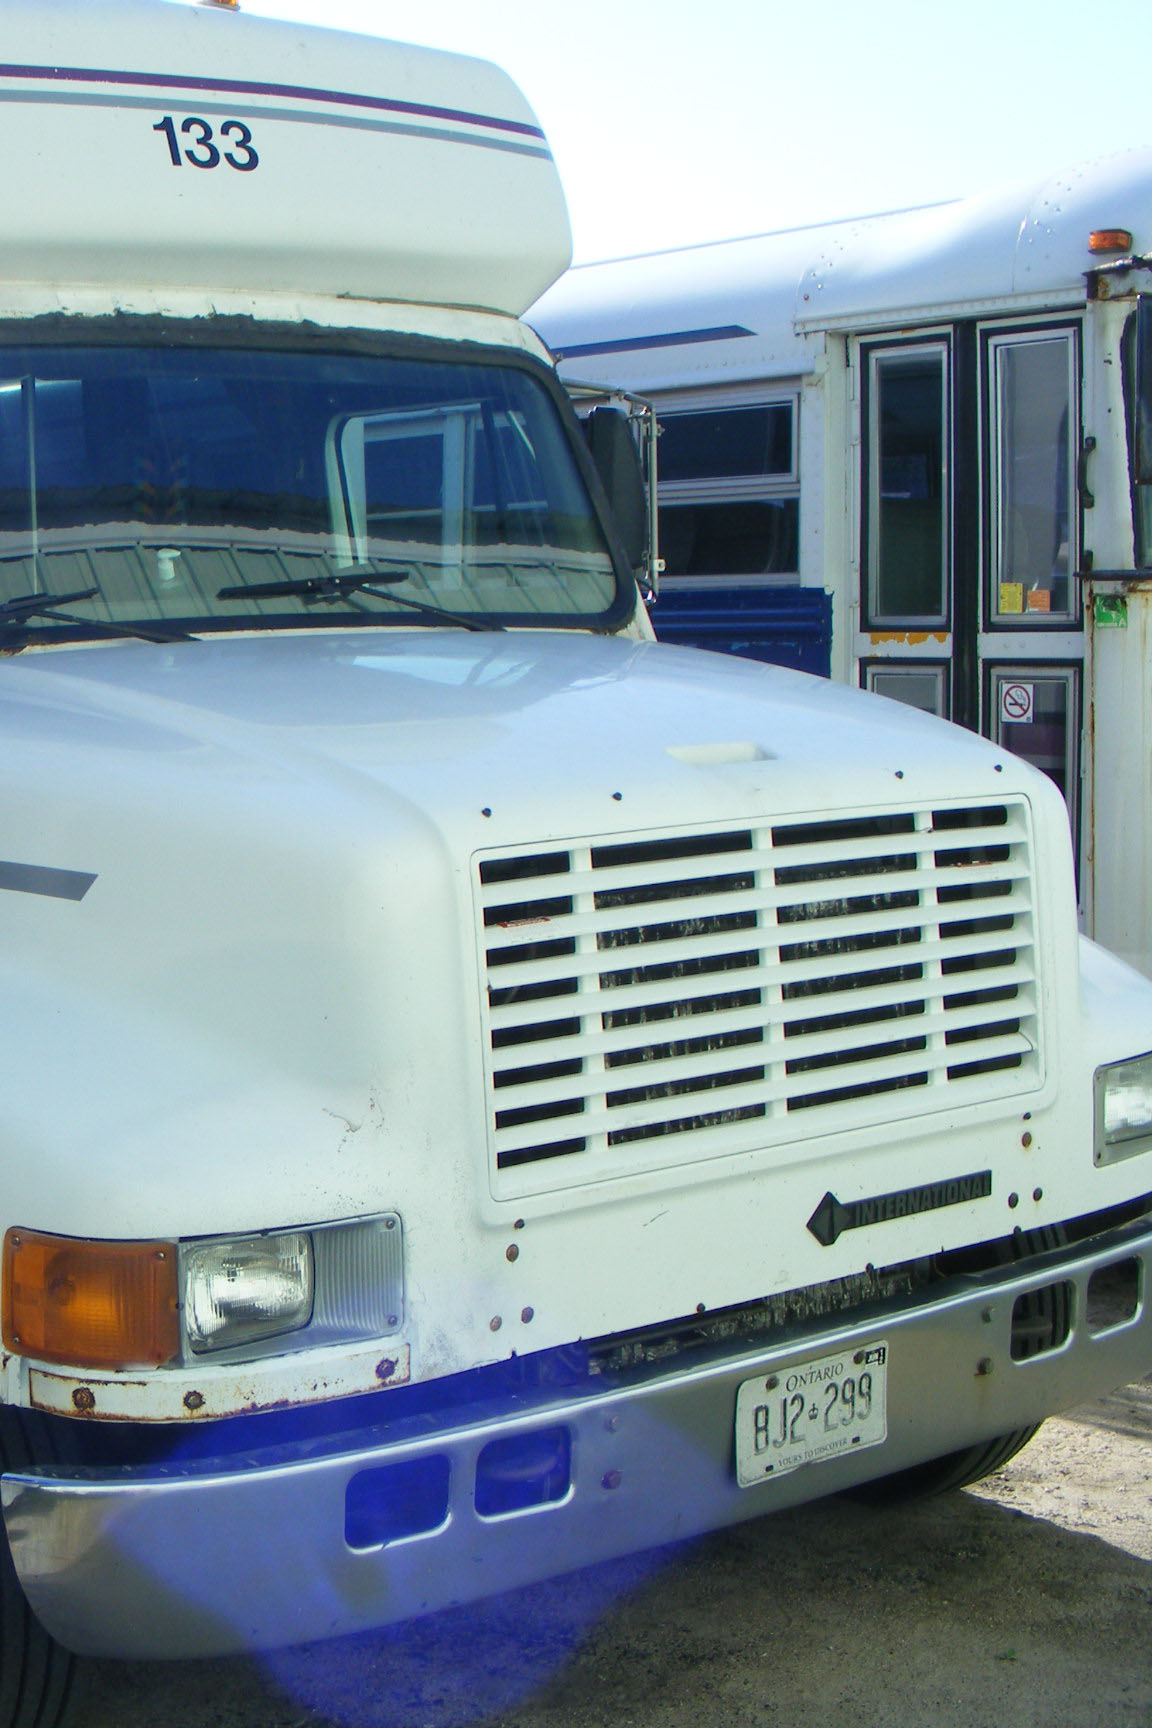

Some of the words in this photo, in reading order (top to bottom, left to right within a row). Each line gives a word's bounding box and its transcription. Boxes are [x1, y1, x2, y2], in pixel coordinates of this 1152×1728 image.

[153, 116, 259, 171] 133
[854, 1172, 991, 1228] INTERNATIONAL
[786, 1363, 844, 1392] ONTARIO
